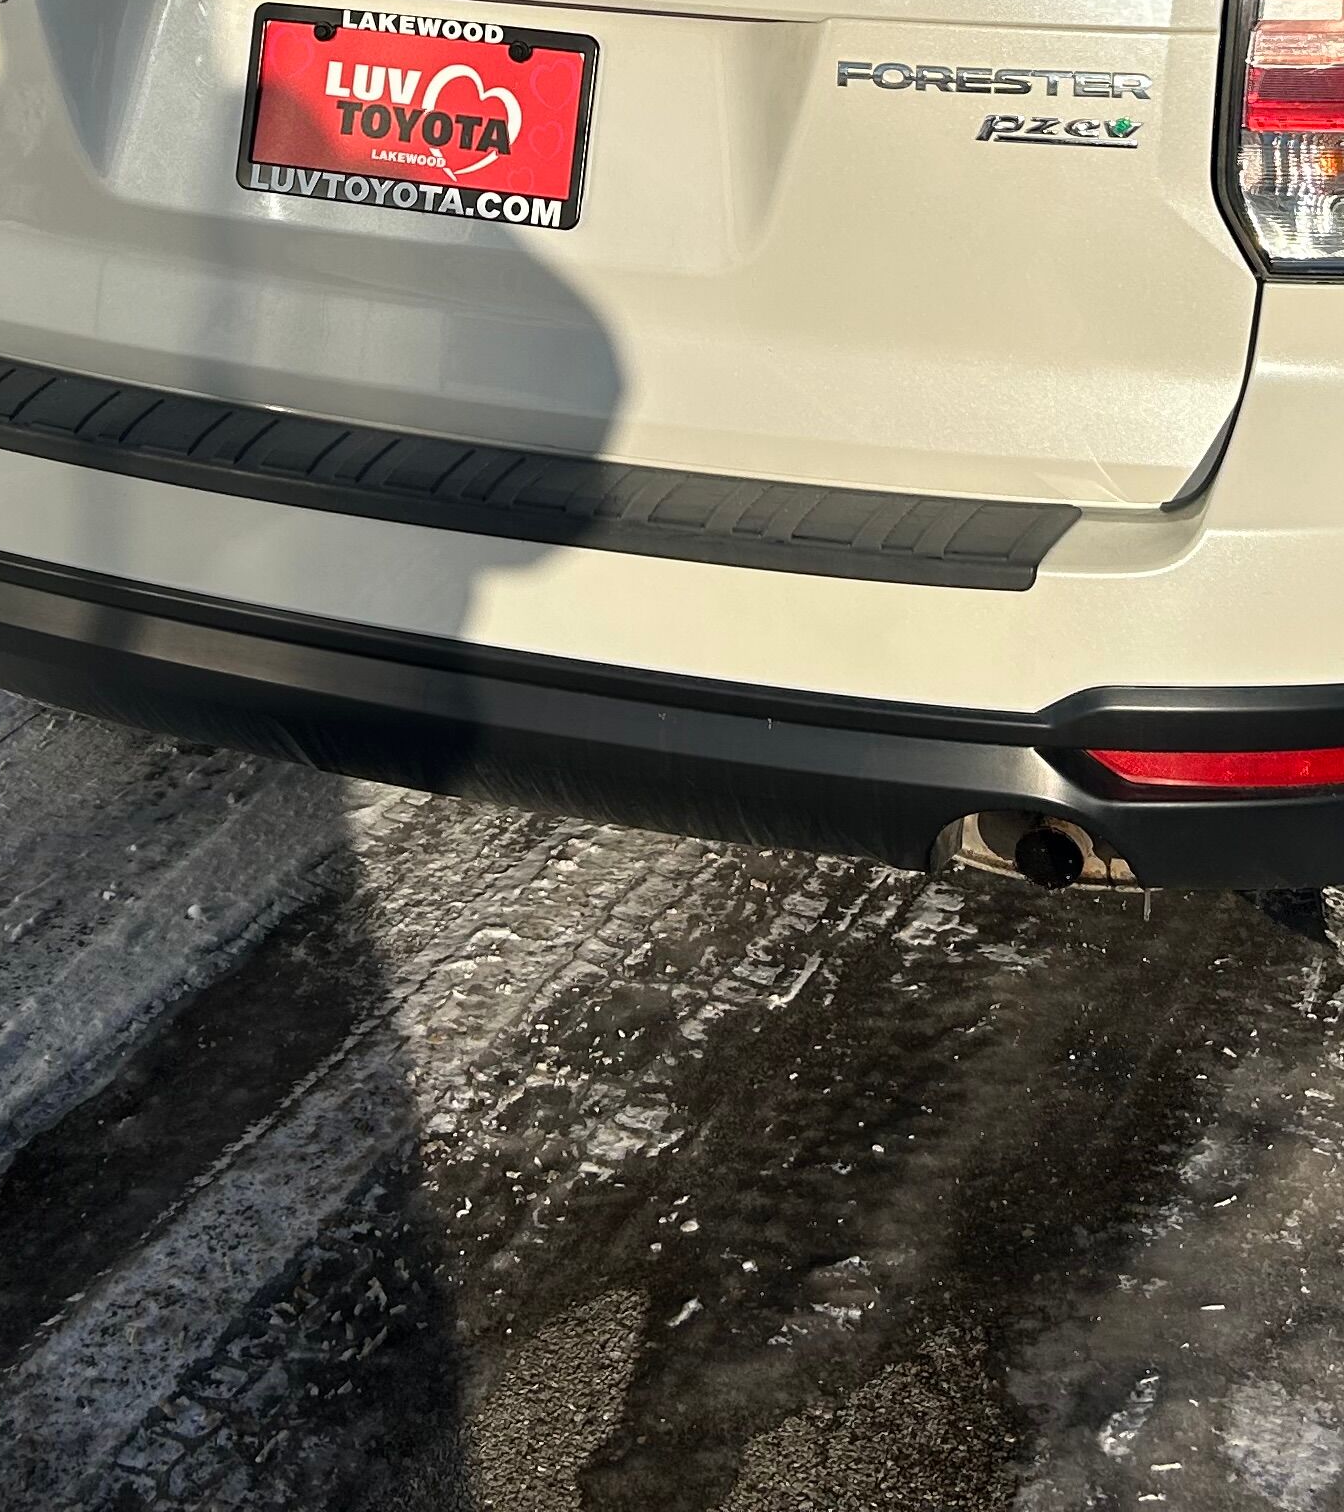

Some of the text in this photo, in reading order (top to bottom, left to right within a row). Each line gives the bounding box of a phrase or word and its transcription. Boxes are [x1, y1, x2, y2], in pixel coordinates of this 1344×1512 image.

[342, 10, 505, 44] LAKEWOOD
[325, 61, 423, 105] LUV
[837, 60, 1153, 100] FORESTER
[336, 100, 512, 155] TOYOTA
[371, 148, 446, 168] LAKEWOOD
[250, 164, 563, 228] LUVTOYOTA.COM
